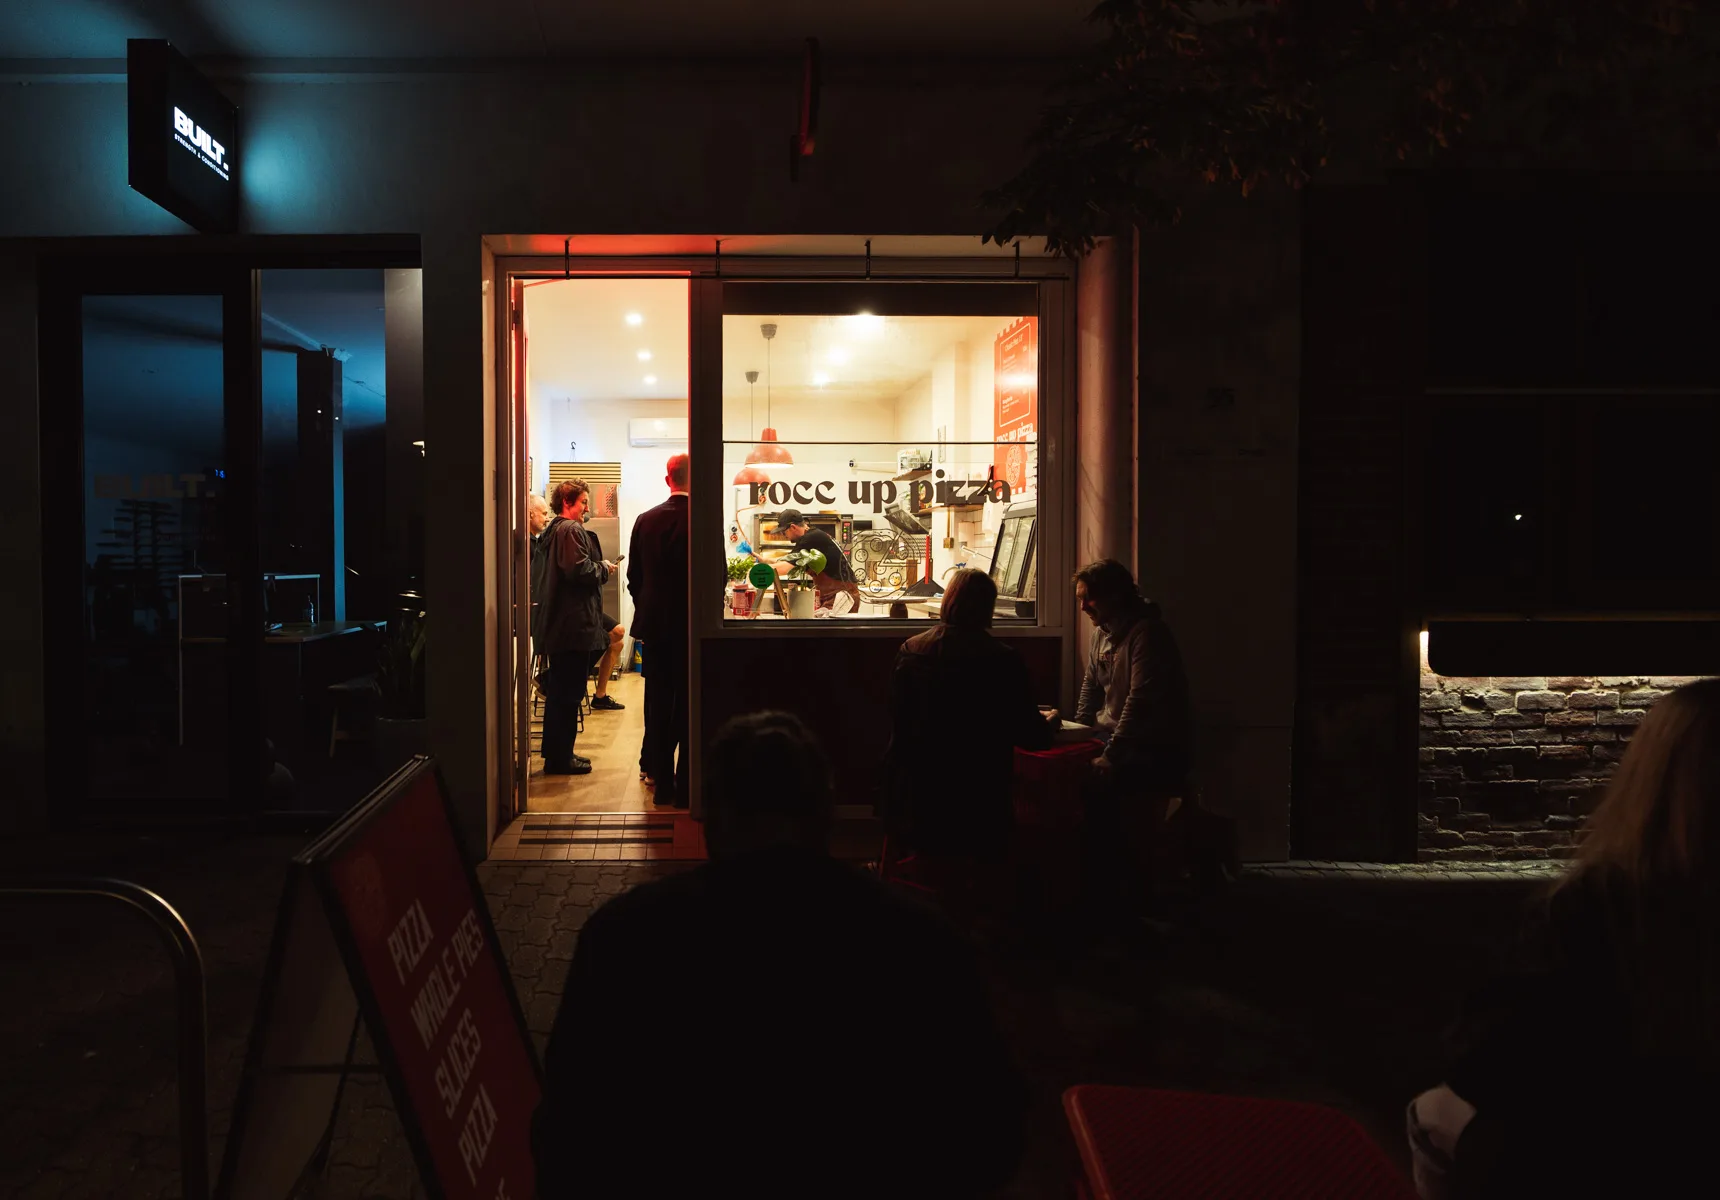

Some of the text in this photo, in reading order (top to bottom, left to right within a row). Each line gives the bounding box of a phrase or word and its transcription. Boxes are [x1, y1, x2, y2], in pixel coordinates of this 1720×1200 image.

[174, 106, 229, 171] BUILT.
[749, 469, 1012, 513] rocc up pizza
[387, 898, 434, 985] PIZZA
[410, 908, 484, 1052] WHOLE PIES
[435, 1007, 482, 1120] SLICES
[458, 1084, 499, 1188] PIZZA
